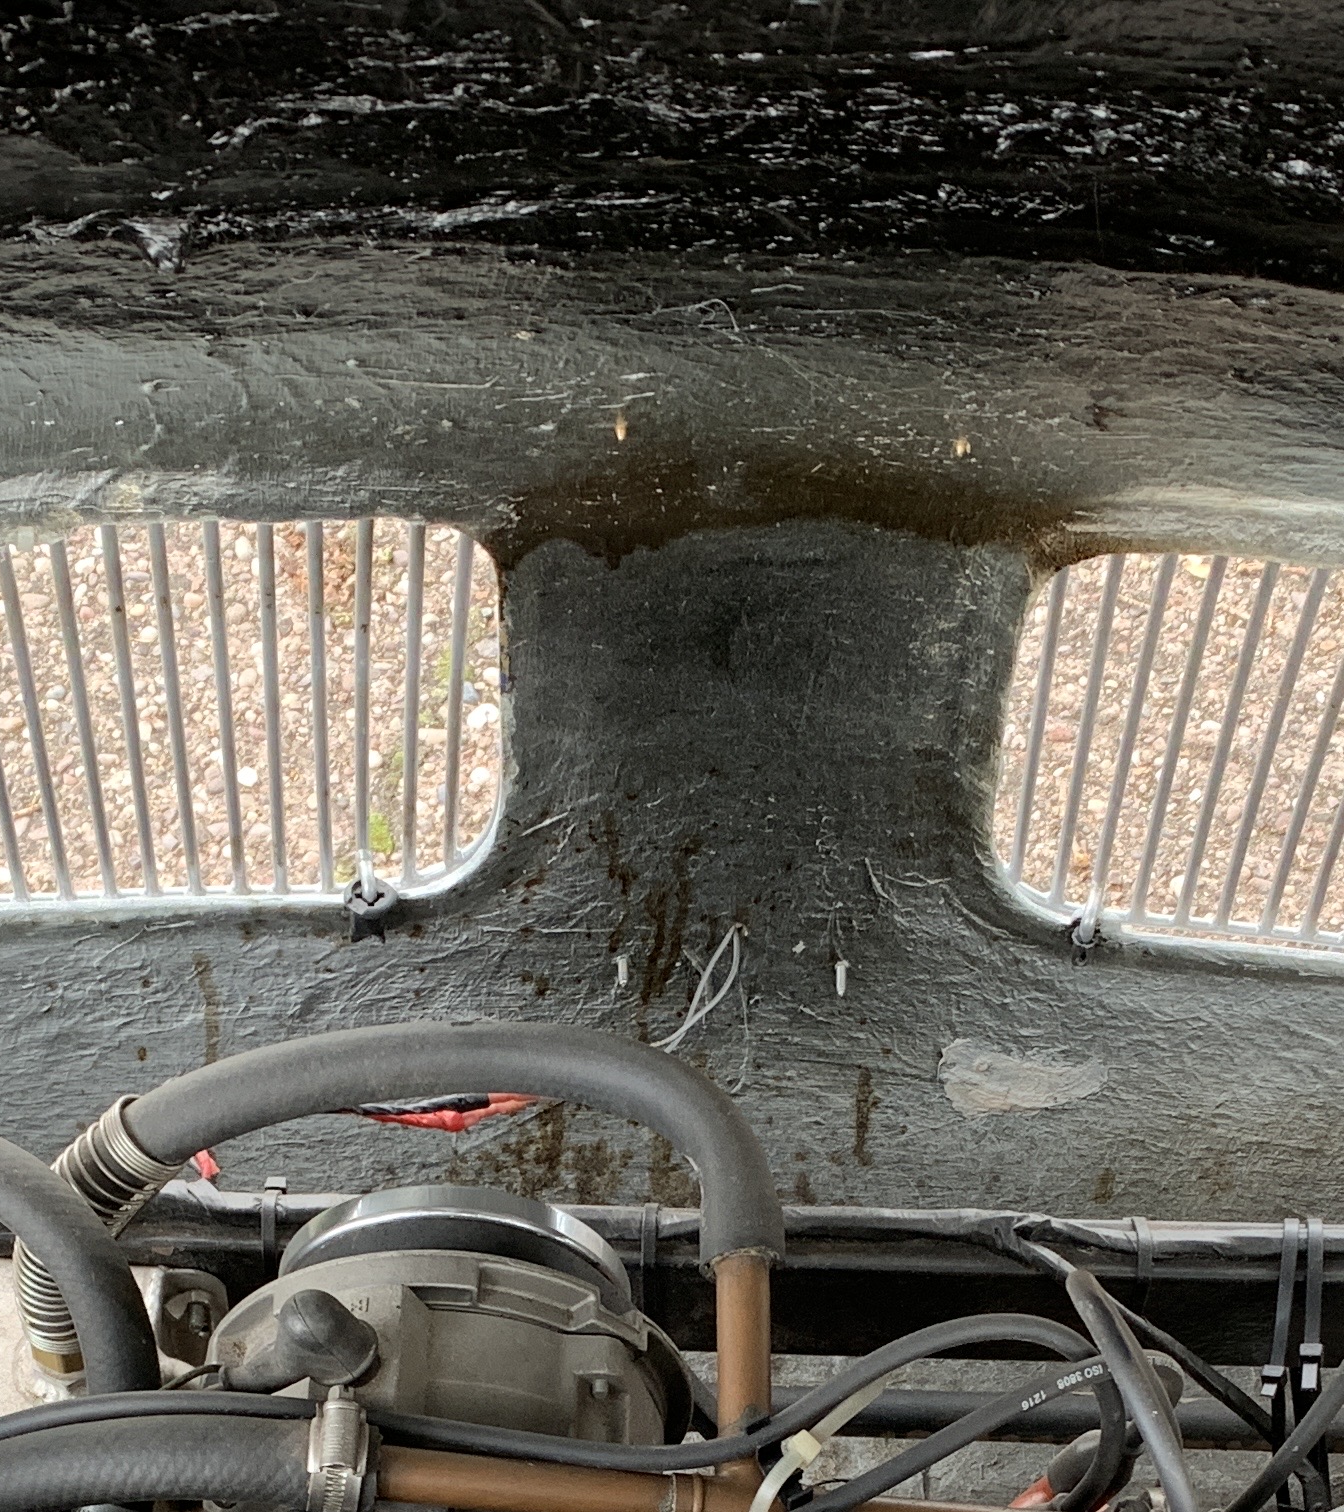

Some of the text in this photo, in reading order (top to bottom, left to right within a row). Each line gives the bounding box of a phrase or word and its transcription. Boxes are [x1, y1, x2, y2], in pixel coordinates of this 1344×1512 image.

[1021, 1364, 1104, 1411] ISO 3808 1216
